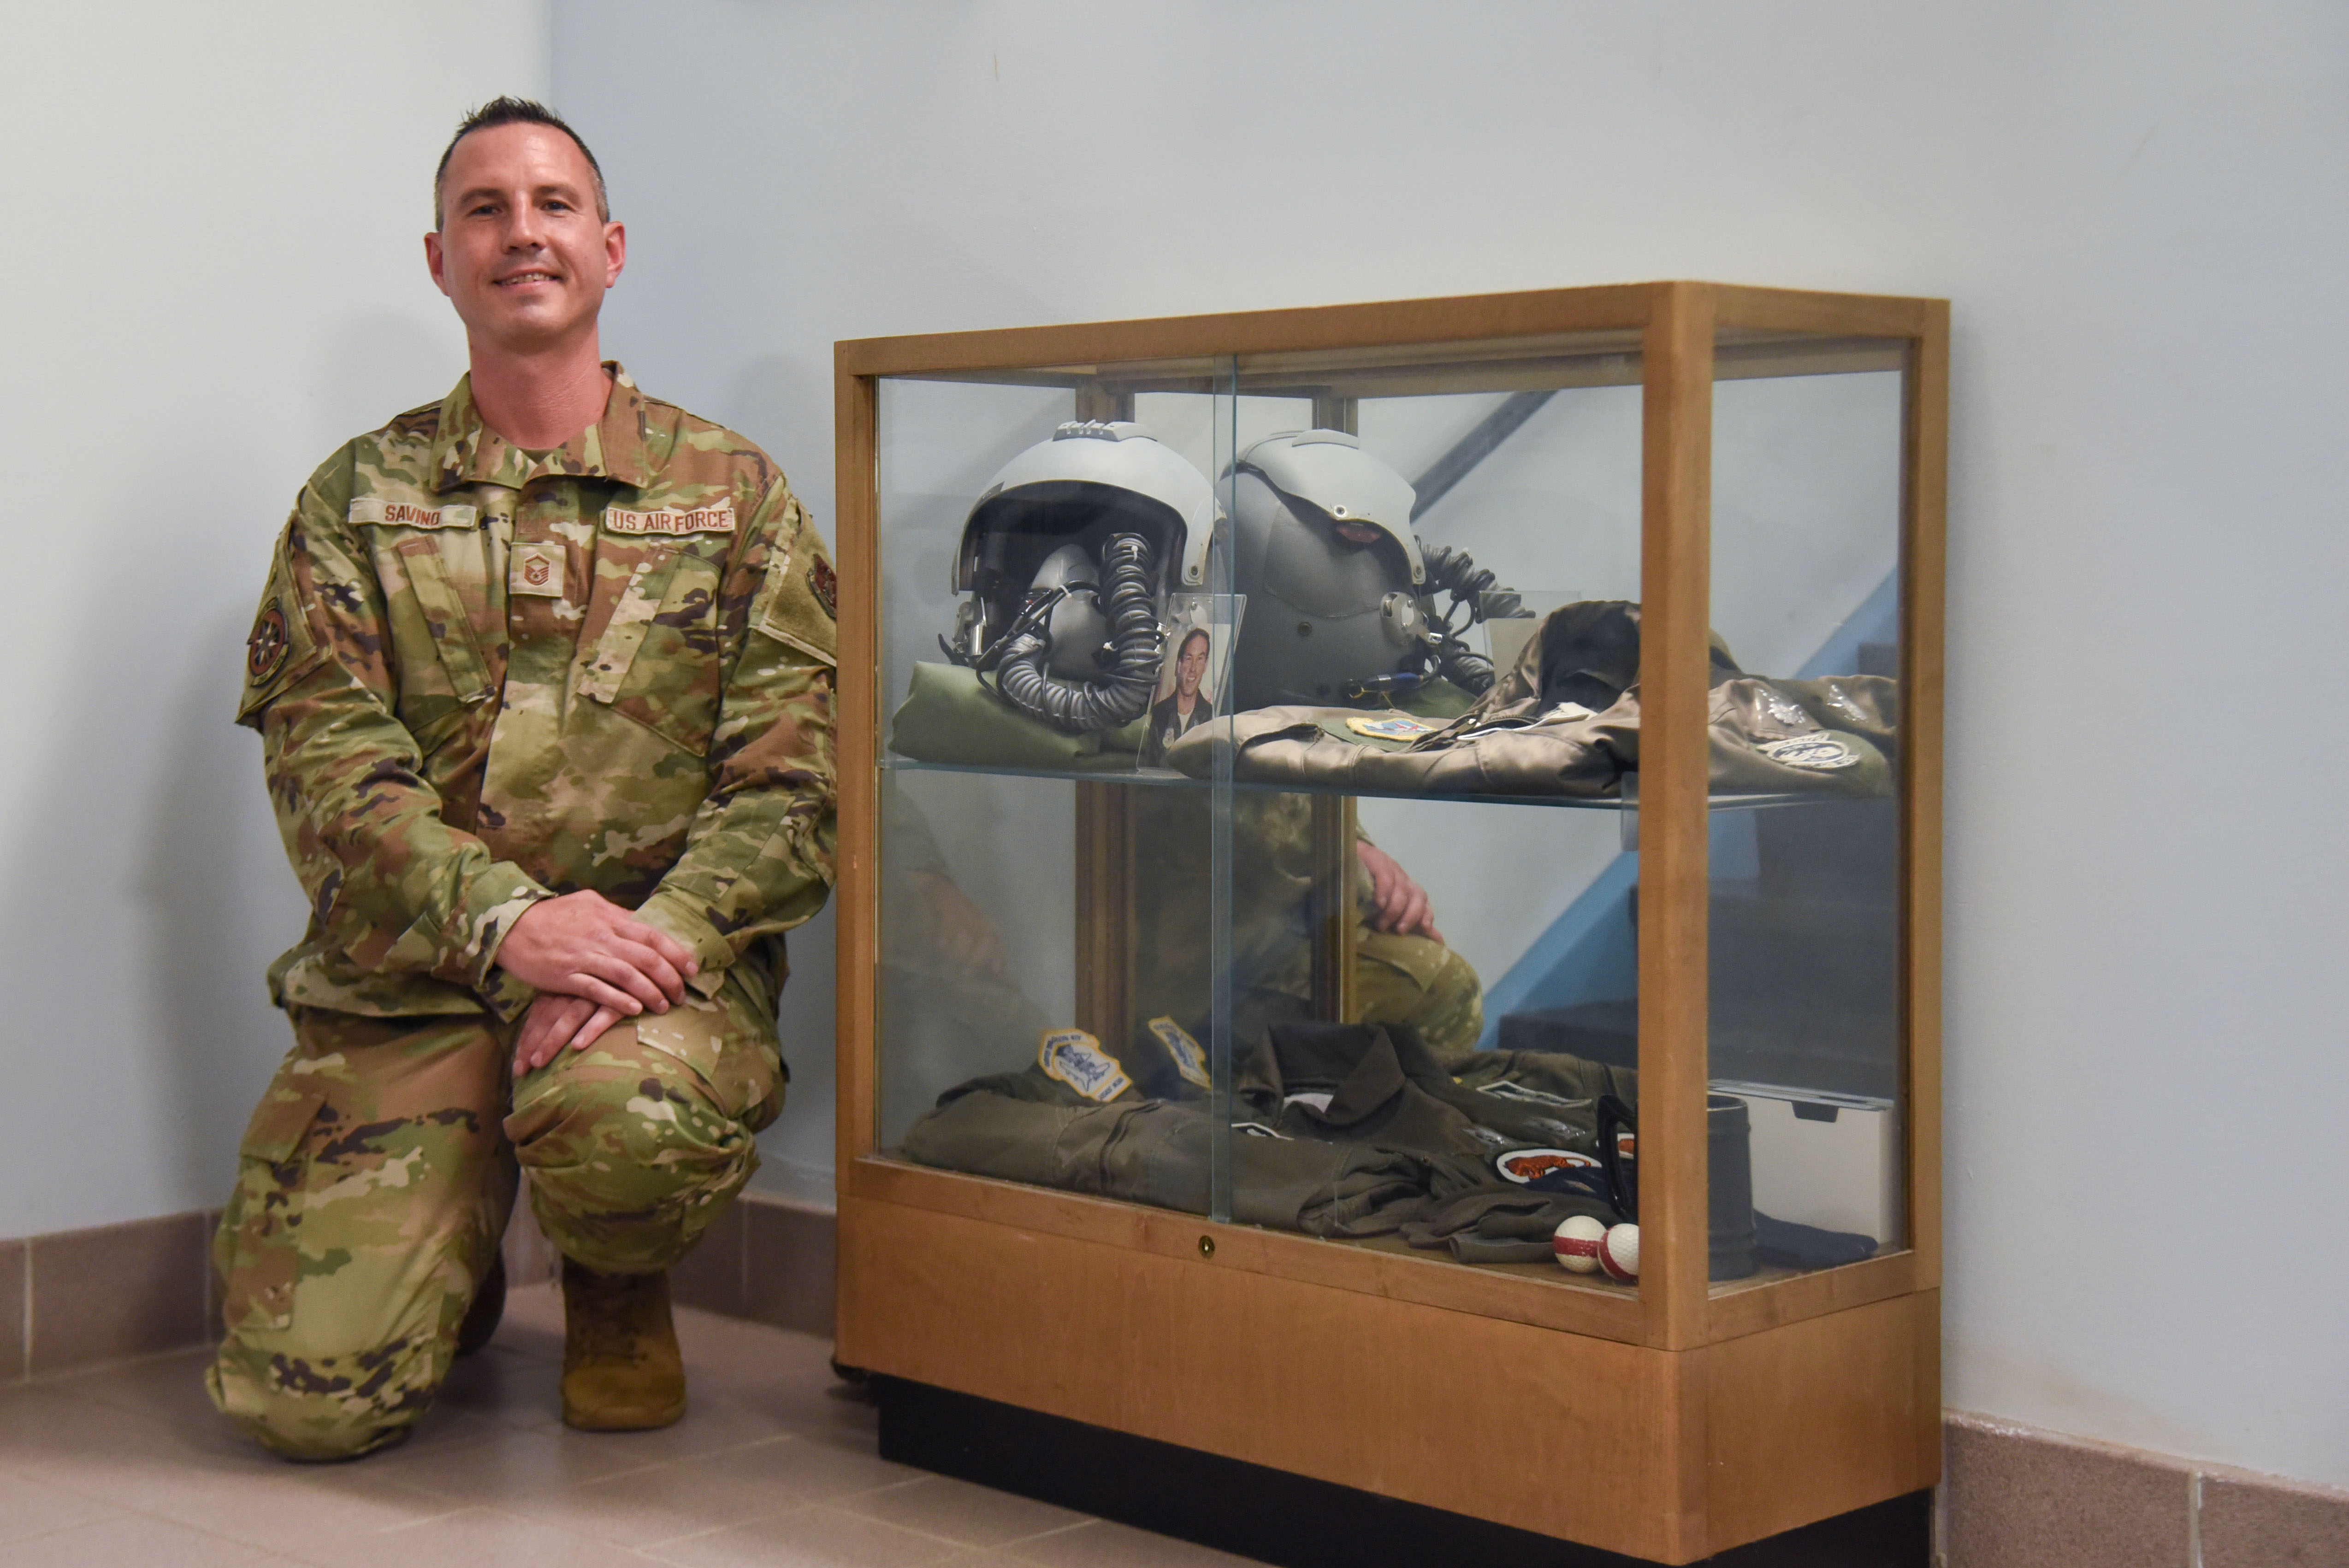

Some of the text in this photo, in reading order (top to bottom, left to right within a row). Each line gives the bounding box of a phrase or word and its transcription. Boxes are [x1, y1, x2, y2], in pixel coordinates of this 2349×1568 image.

[385, 504, 441, 526] SAVINO
[614, 510, 728, 532] US AIR FORCE
